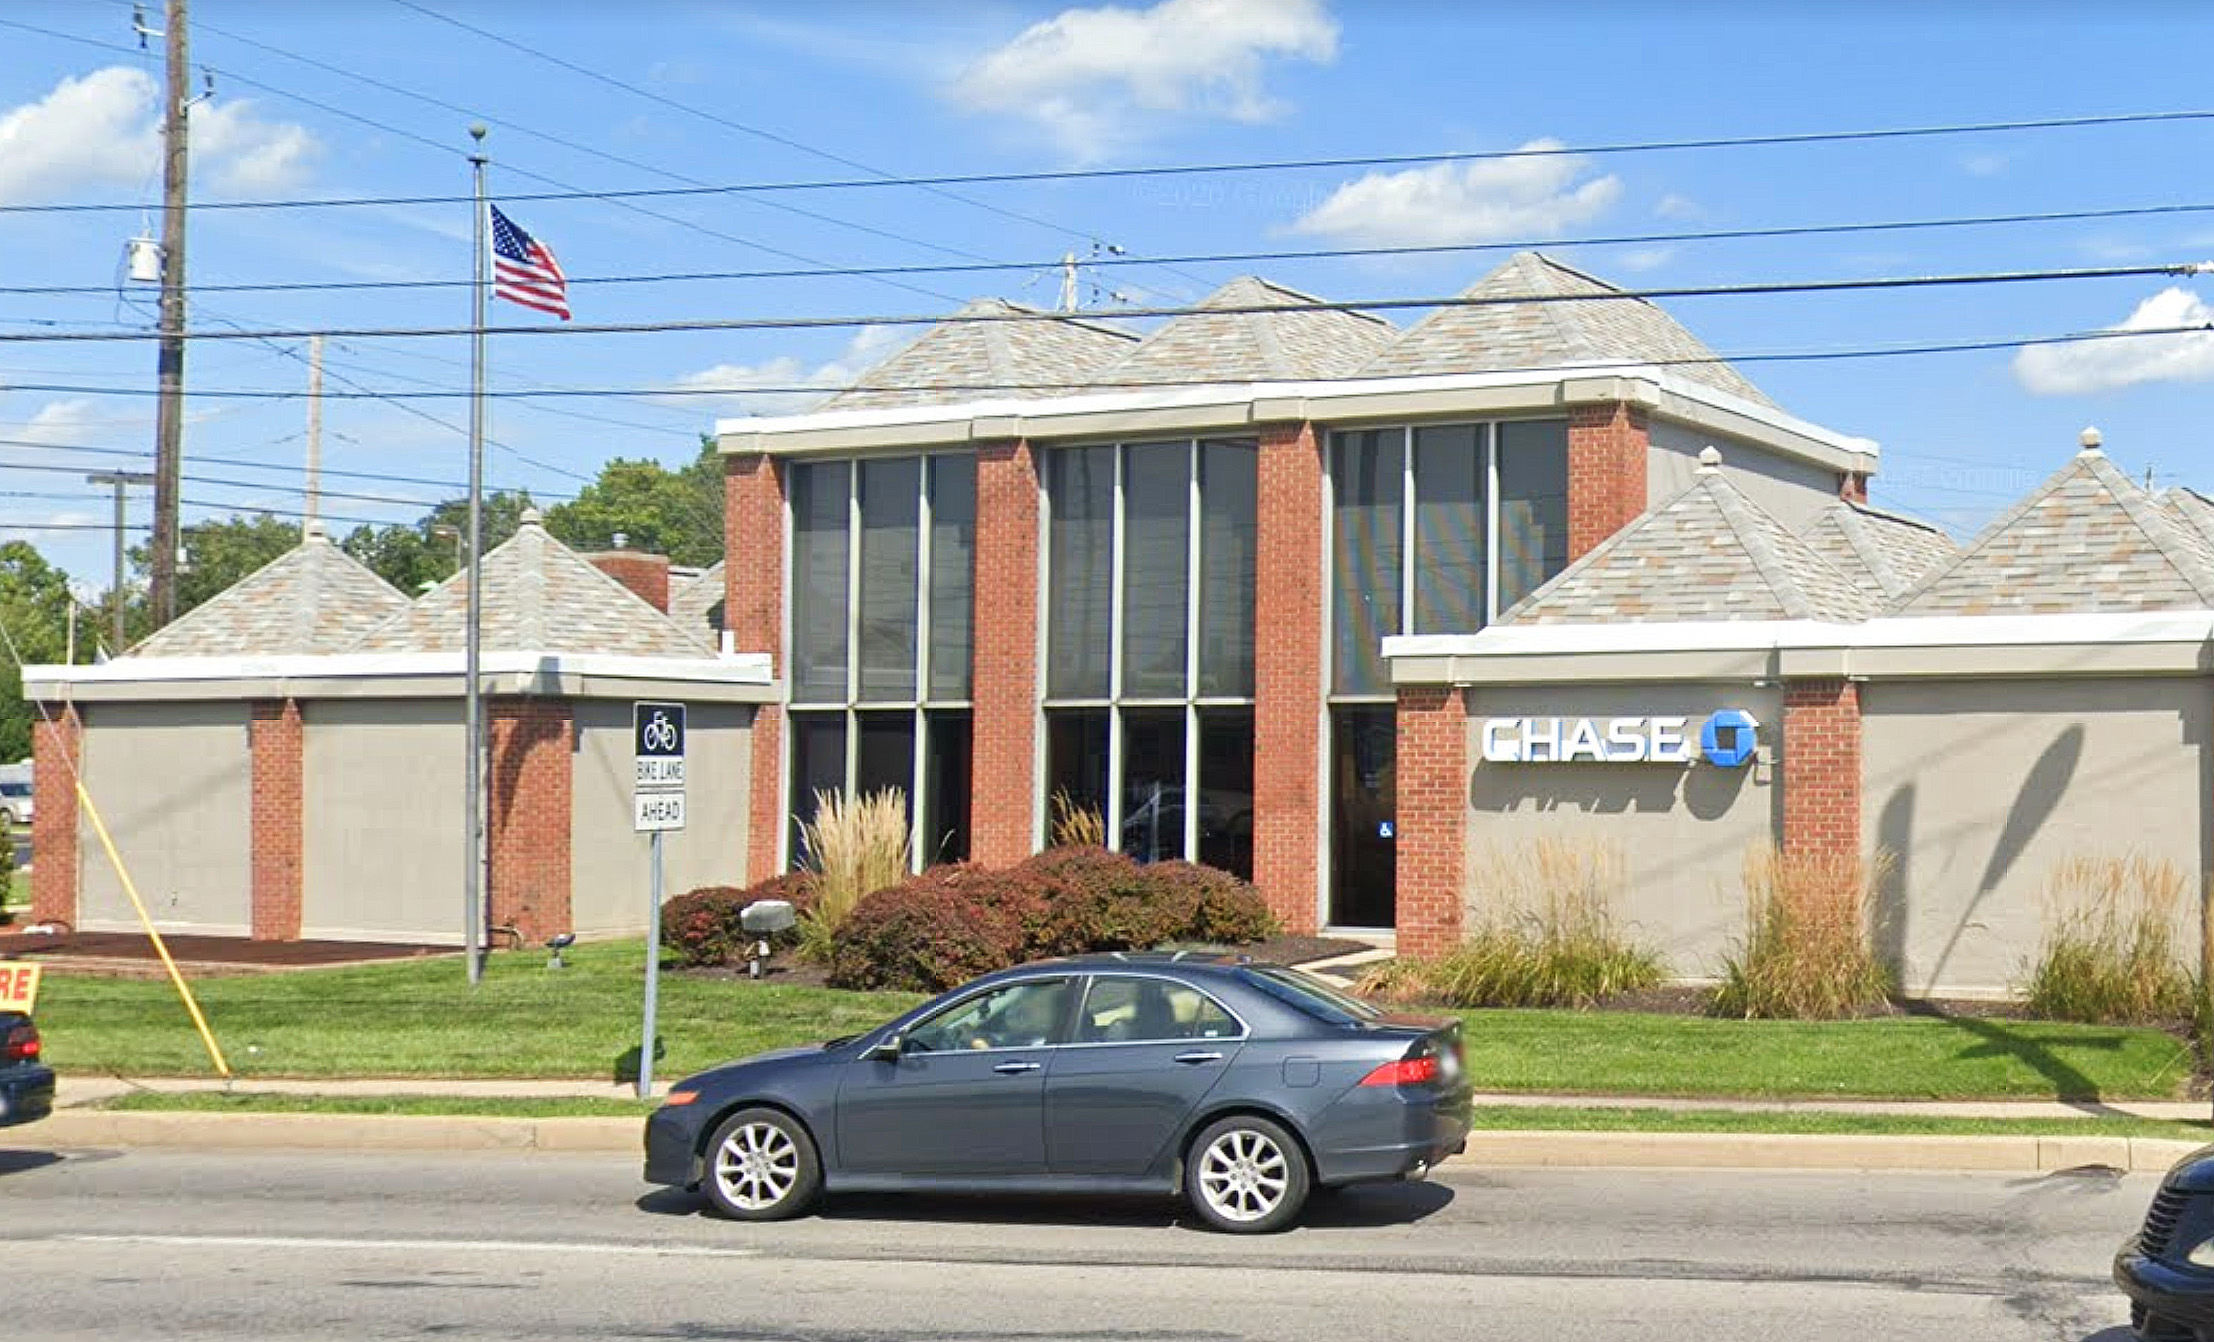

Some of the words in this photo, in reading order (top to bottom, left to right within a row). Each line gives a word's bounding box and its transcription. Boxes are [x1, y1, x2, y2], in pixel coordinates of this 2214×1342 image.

[1483, 717, 1691, 762] CHASE
[636, 760, 658, 780] BIKE
[660, 760, 683, 780] LANE
[640, 801, 680, 821] AHEAD
